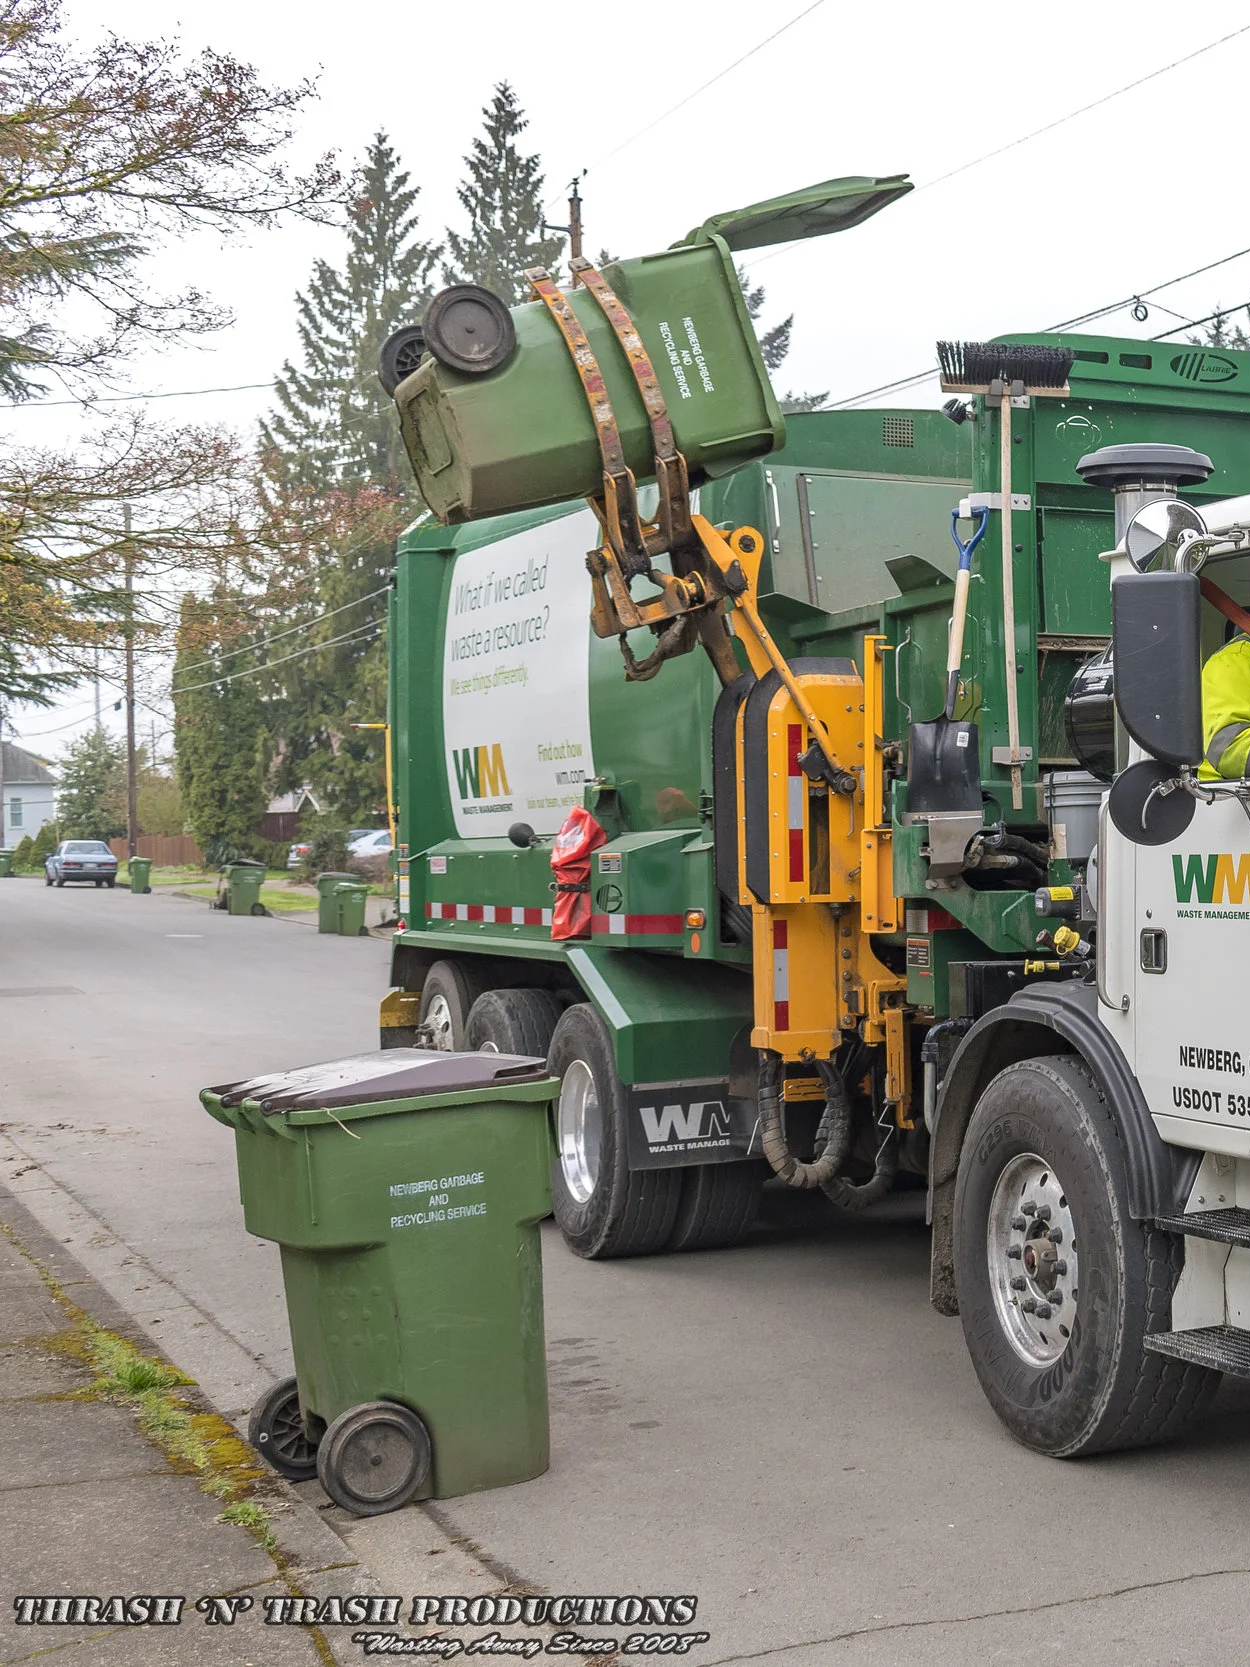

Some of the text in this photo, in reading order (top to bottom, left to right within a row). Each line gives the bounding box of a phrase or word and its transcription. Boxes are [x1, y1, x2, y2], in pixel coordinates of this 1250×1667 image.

[659, 322, 692, 399] RECYCLING SERVICE
[680, 349, 692, 366] AND
[682, 317, 715, 393] NEWBERG GARBAGE
[1201, 365, 1232, 374] LABRIE
[455, 553, 549, 615] What if we called
[452, 605, 550, 661] waste a resource?
[472, 671, 491, 695] things
[538, 739, 582, 762] Find out how
[452, 743, 511, 800] WM
[555, 769, 586, 785] wm.com
[462, 803, 514, 815] WASTE MANAGEMENT
[1177, 910, 1202, 919] WASTE
[1179, 1045, 1245, 1077] NEWBERG,
[1172, 1086, 1221, 1113] USDOT
[649, 1143, 685, 1153] WASTE
[389, 1171, 485, 1197] NEWBERG GARBAGE
[428, 1193, 449, 1207] AND
[390, 1202, 487, 1228] RECYCLING SERVICE
